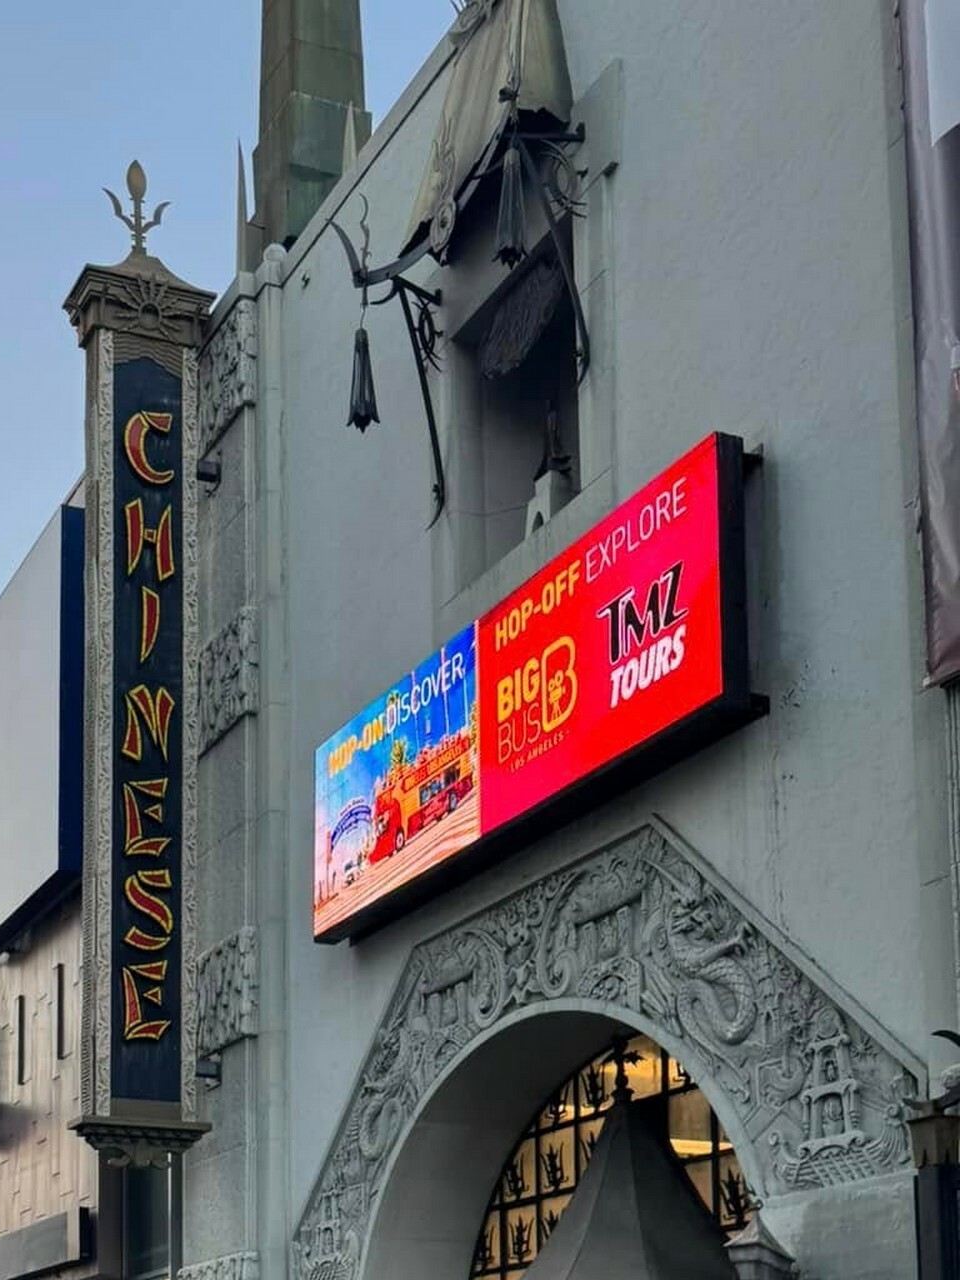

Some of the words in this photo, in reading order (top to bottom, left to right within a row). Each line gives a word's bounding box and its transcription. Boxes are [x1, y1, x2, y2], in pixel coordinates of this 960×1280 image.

[495, 560, 581, 651] HOP-OFF
[586, 476, 688, 584] EXPLORE
[596, 560, 689, 666] TMZ
[497, 657, 541, 723] BIG
[610, 625, 687, 709] TOURS
[123, 411, 175, 1042] CHINESE
[498, 702, 541, 764] BUS
[509, 755, 525, 774] LOS
[527, 731, 565, 763] ANGELES
